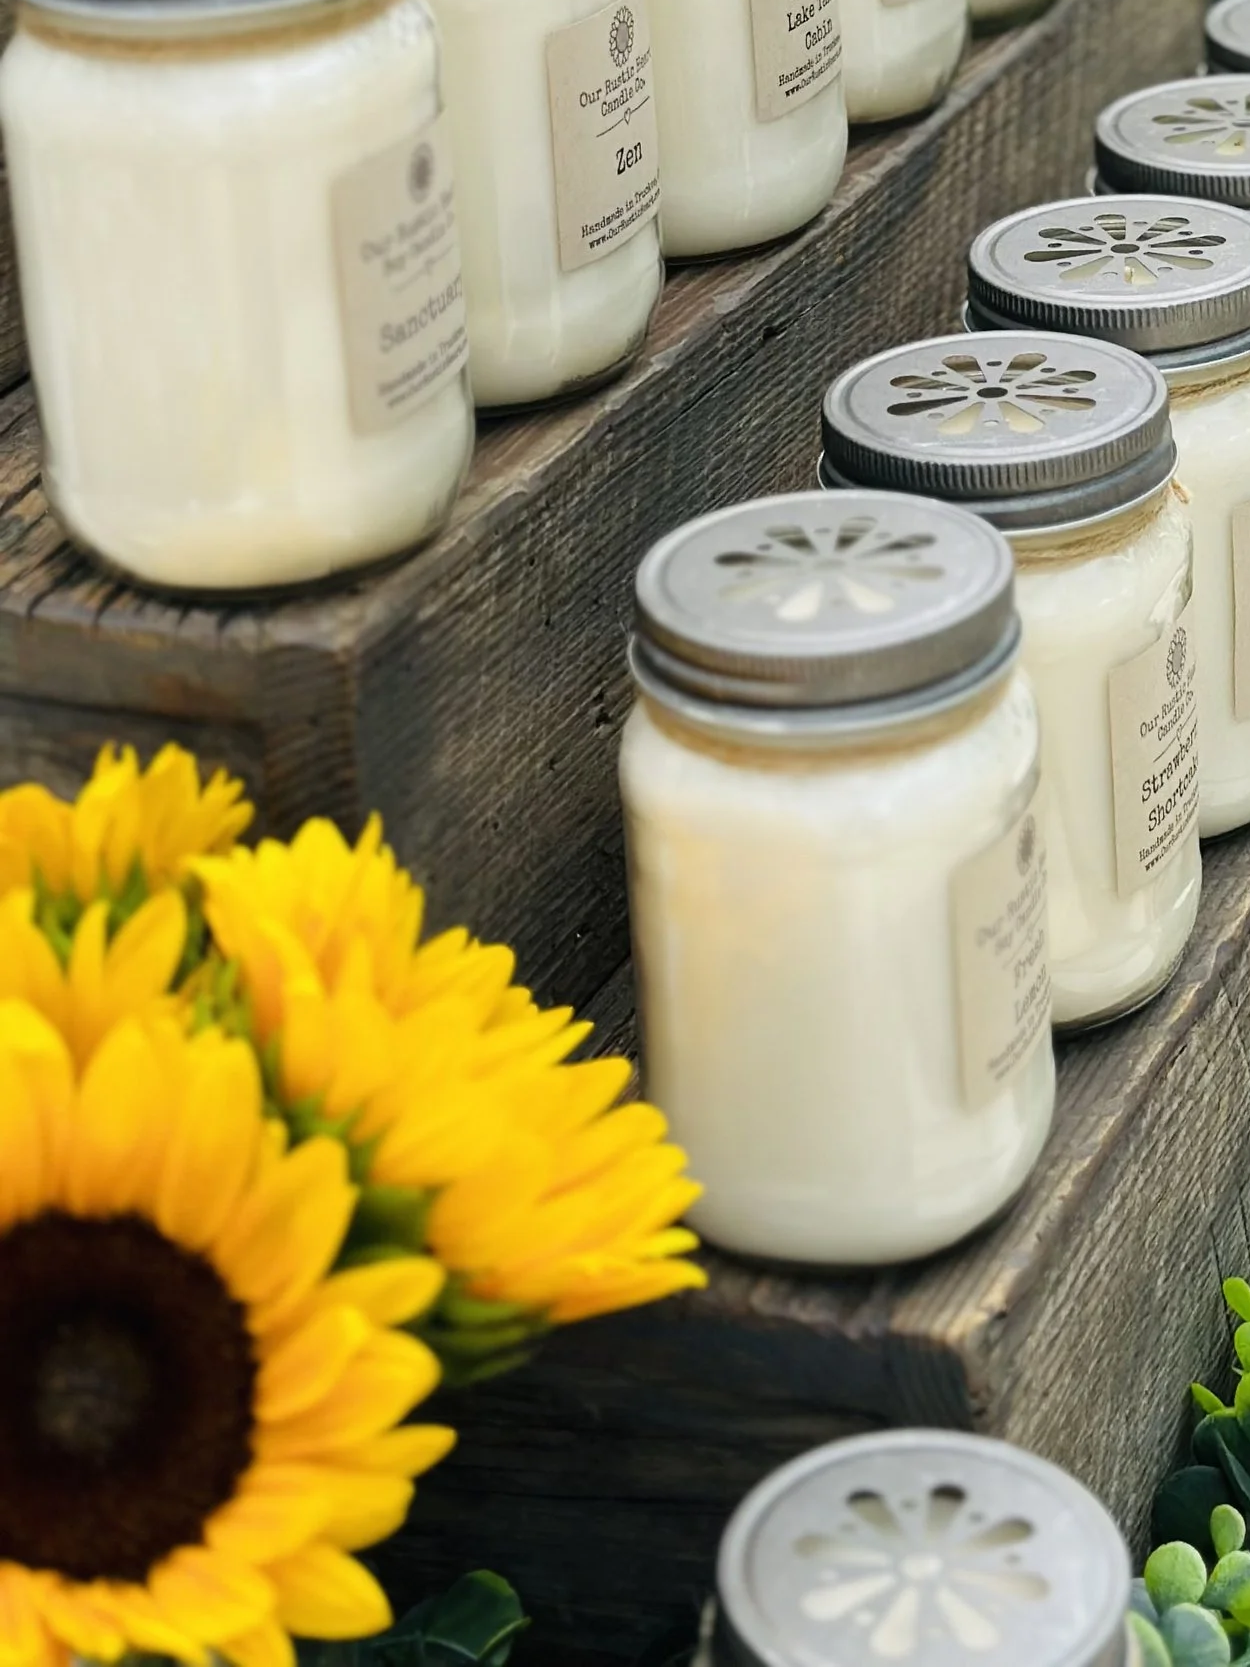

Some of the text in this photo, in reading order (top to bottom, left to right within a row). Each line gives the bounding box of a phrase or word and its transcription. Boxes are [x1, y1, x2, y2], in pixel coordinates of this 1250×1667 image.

[787, 3, 815, 33] Lake
[805, 18, 833, 51] Cabin
[580, 88, 602, 108] Our
[605, 66, 635, 96] Rustic
[778, 58, 814, 87] Handmade
[601, 87, 634, 117] Candle
[616, 141, 643, 176] Zen
[581, 207, 624, 238] Handmade
[625, 199, 634, 212] in
[1140, 682, 1186, 738] Our Rustic
[1158, 703, 1184, 741] Candle
[1148, 752, 1199, 832] Shortcak
[1139, 823, 1174, 862] Handmade
[1014, 929, 1044, 988] Fresh
[1015, 964, 1047, 1025] Lemon
